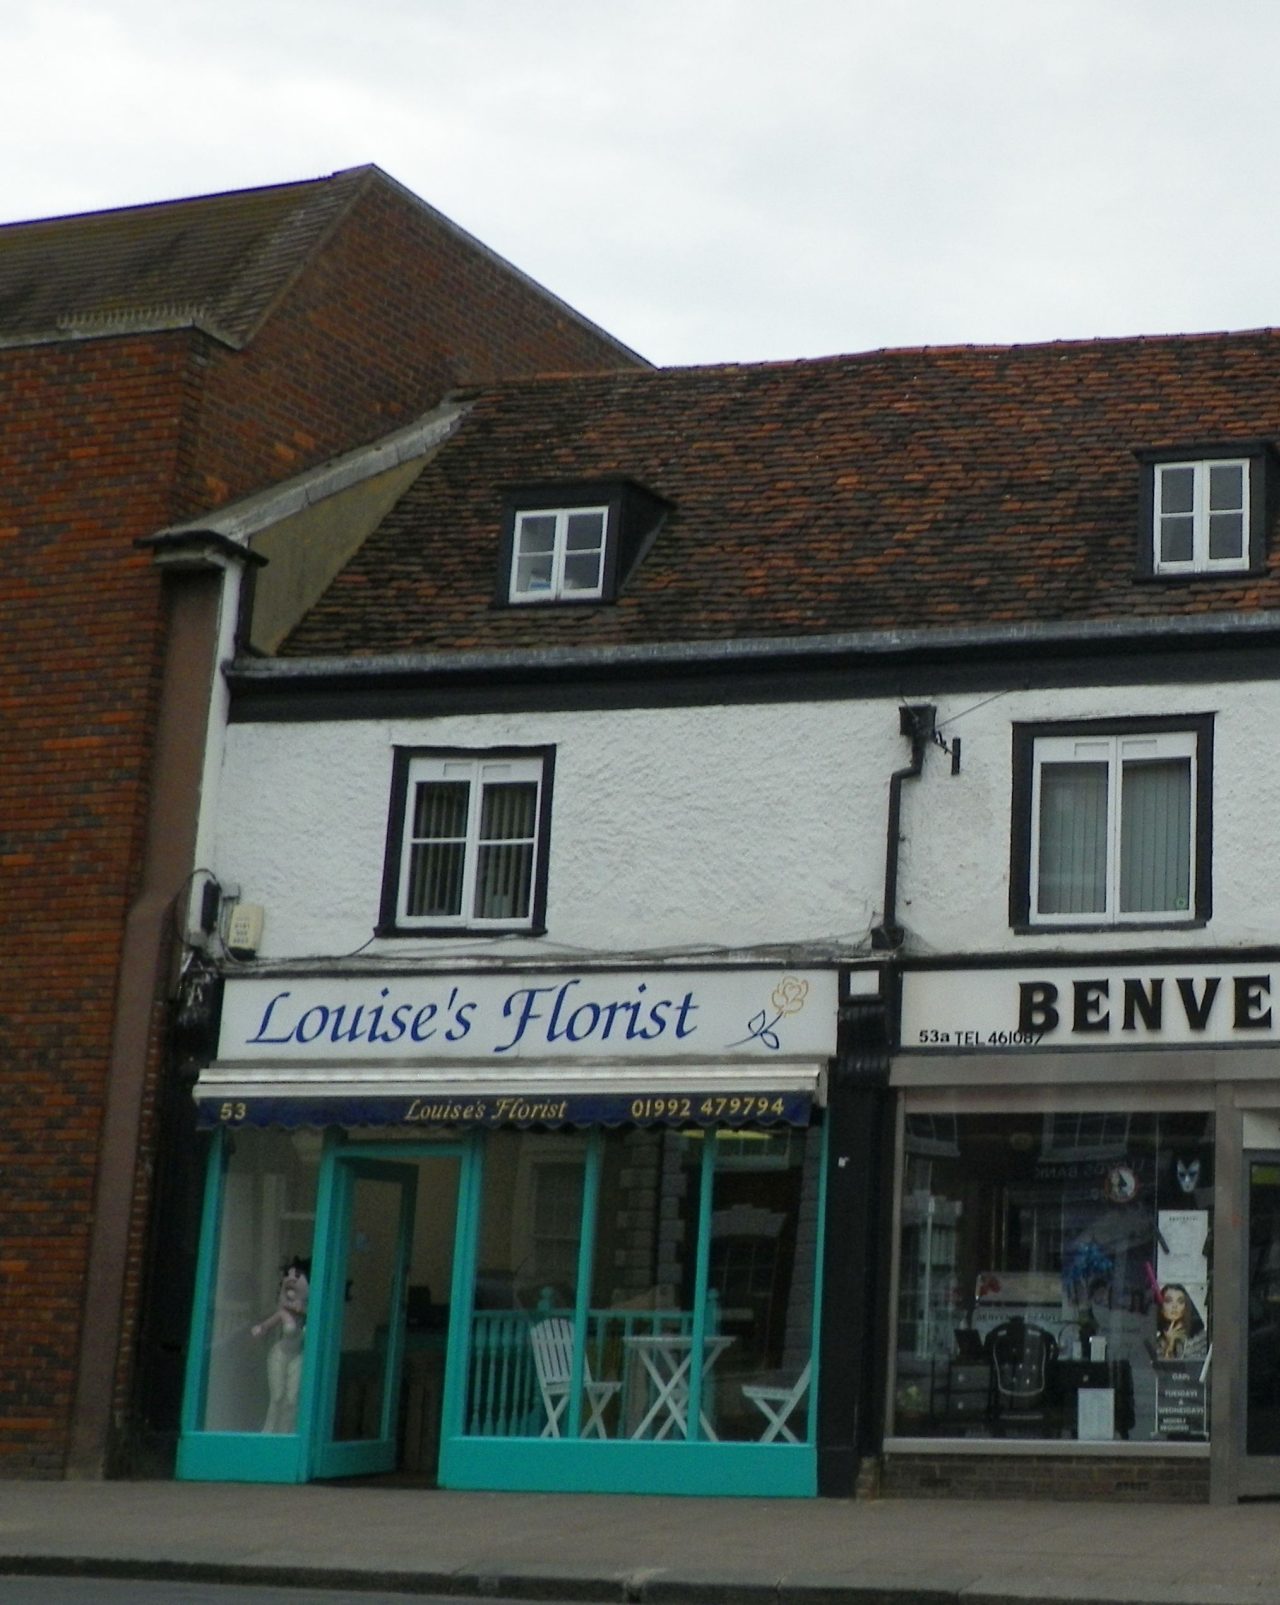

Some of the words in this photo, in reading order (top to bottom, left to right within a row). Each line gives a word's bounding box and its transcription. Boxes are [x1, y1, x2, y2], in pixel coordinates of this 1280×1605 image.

[245, 987, 477, 1044] Louise's
[494, 979, 700, 1053] Florist
[918, 1029, 950, 1043] 53a
[987, 1030, 1044, 1046] 461087
[220, 1102, 247, 1120] 53
[404, 1099, 486, 1121] Louise's
[492, 1097, 569, 1121] Florist
[632, 1099, 691, 1118] 01992
[700, 1097, 785, 1116] 479794
